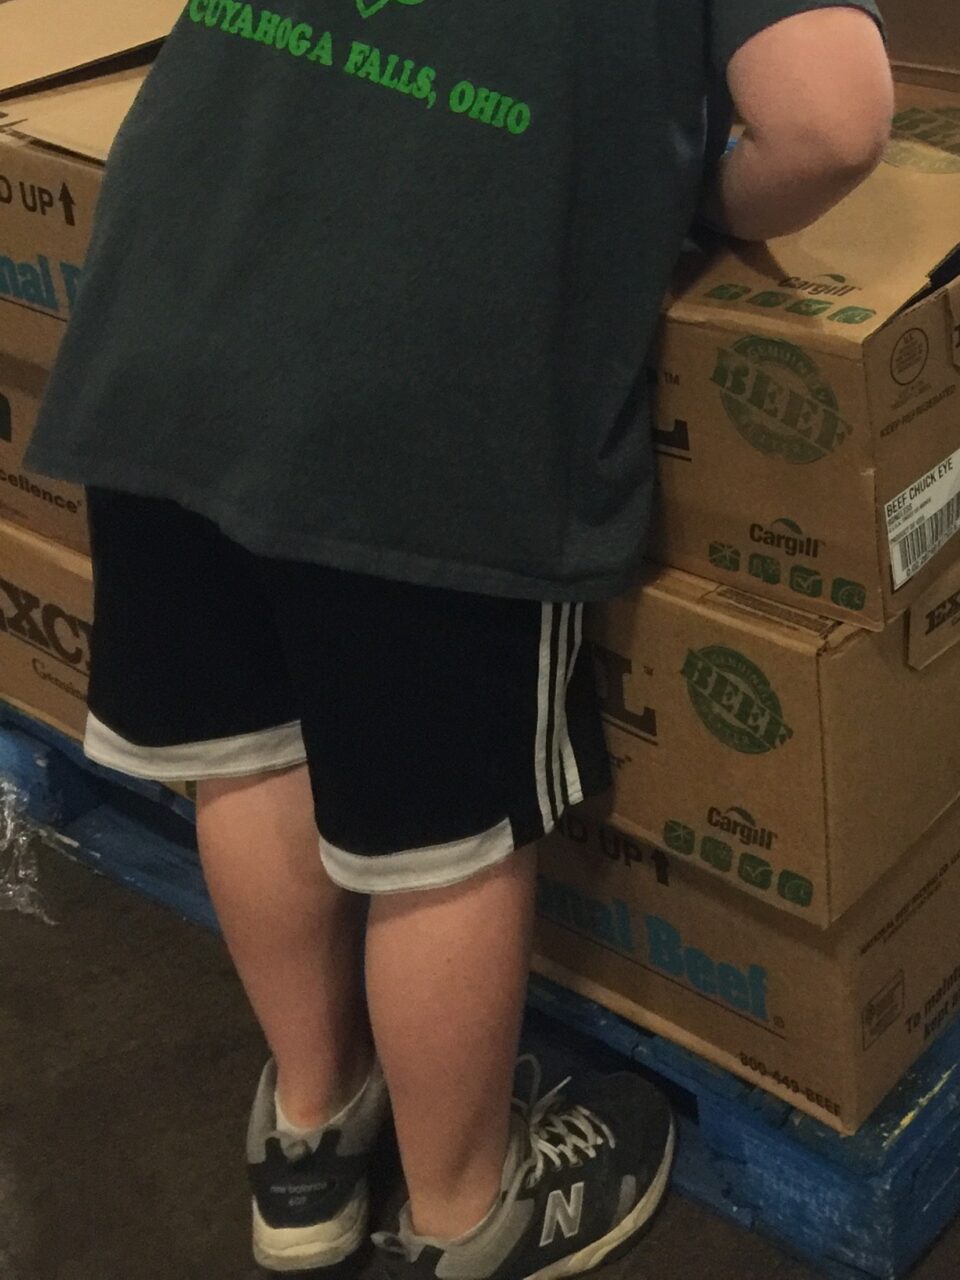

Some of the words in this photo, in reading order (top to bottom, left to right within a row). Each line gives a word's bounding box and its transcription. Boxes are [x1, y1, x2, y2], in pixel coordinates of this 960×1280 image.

[344, 40, 437, 109] FALLS,
[449, 80, 531, 134] OHIO
[19, 181, 54, 216] UP
[777, 276, 857, 297] Cargill
[886, 496, 907, 518] BEEF
[908, 473, 937, 501] CHUCK
[938, 456, 954, 479] EYE
[750, 523, 820, 558] Cargill
[681, 648, 793, 749] BEEF
[600, 828, 643, 870] UP
[707, 806, 772, 851] Cargill
[645, 914, 769, 1021] Beef
[539, 1181, 584, 1247] N
